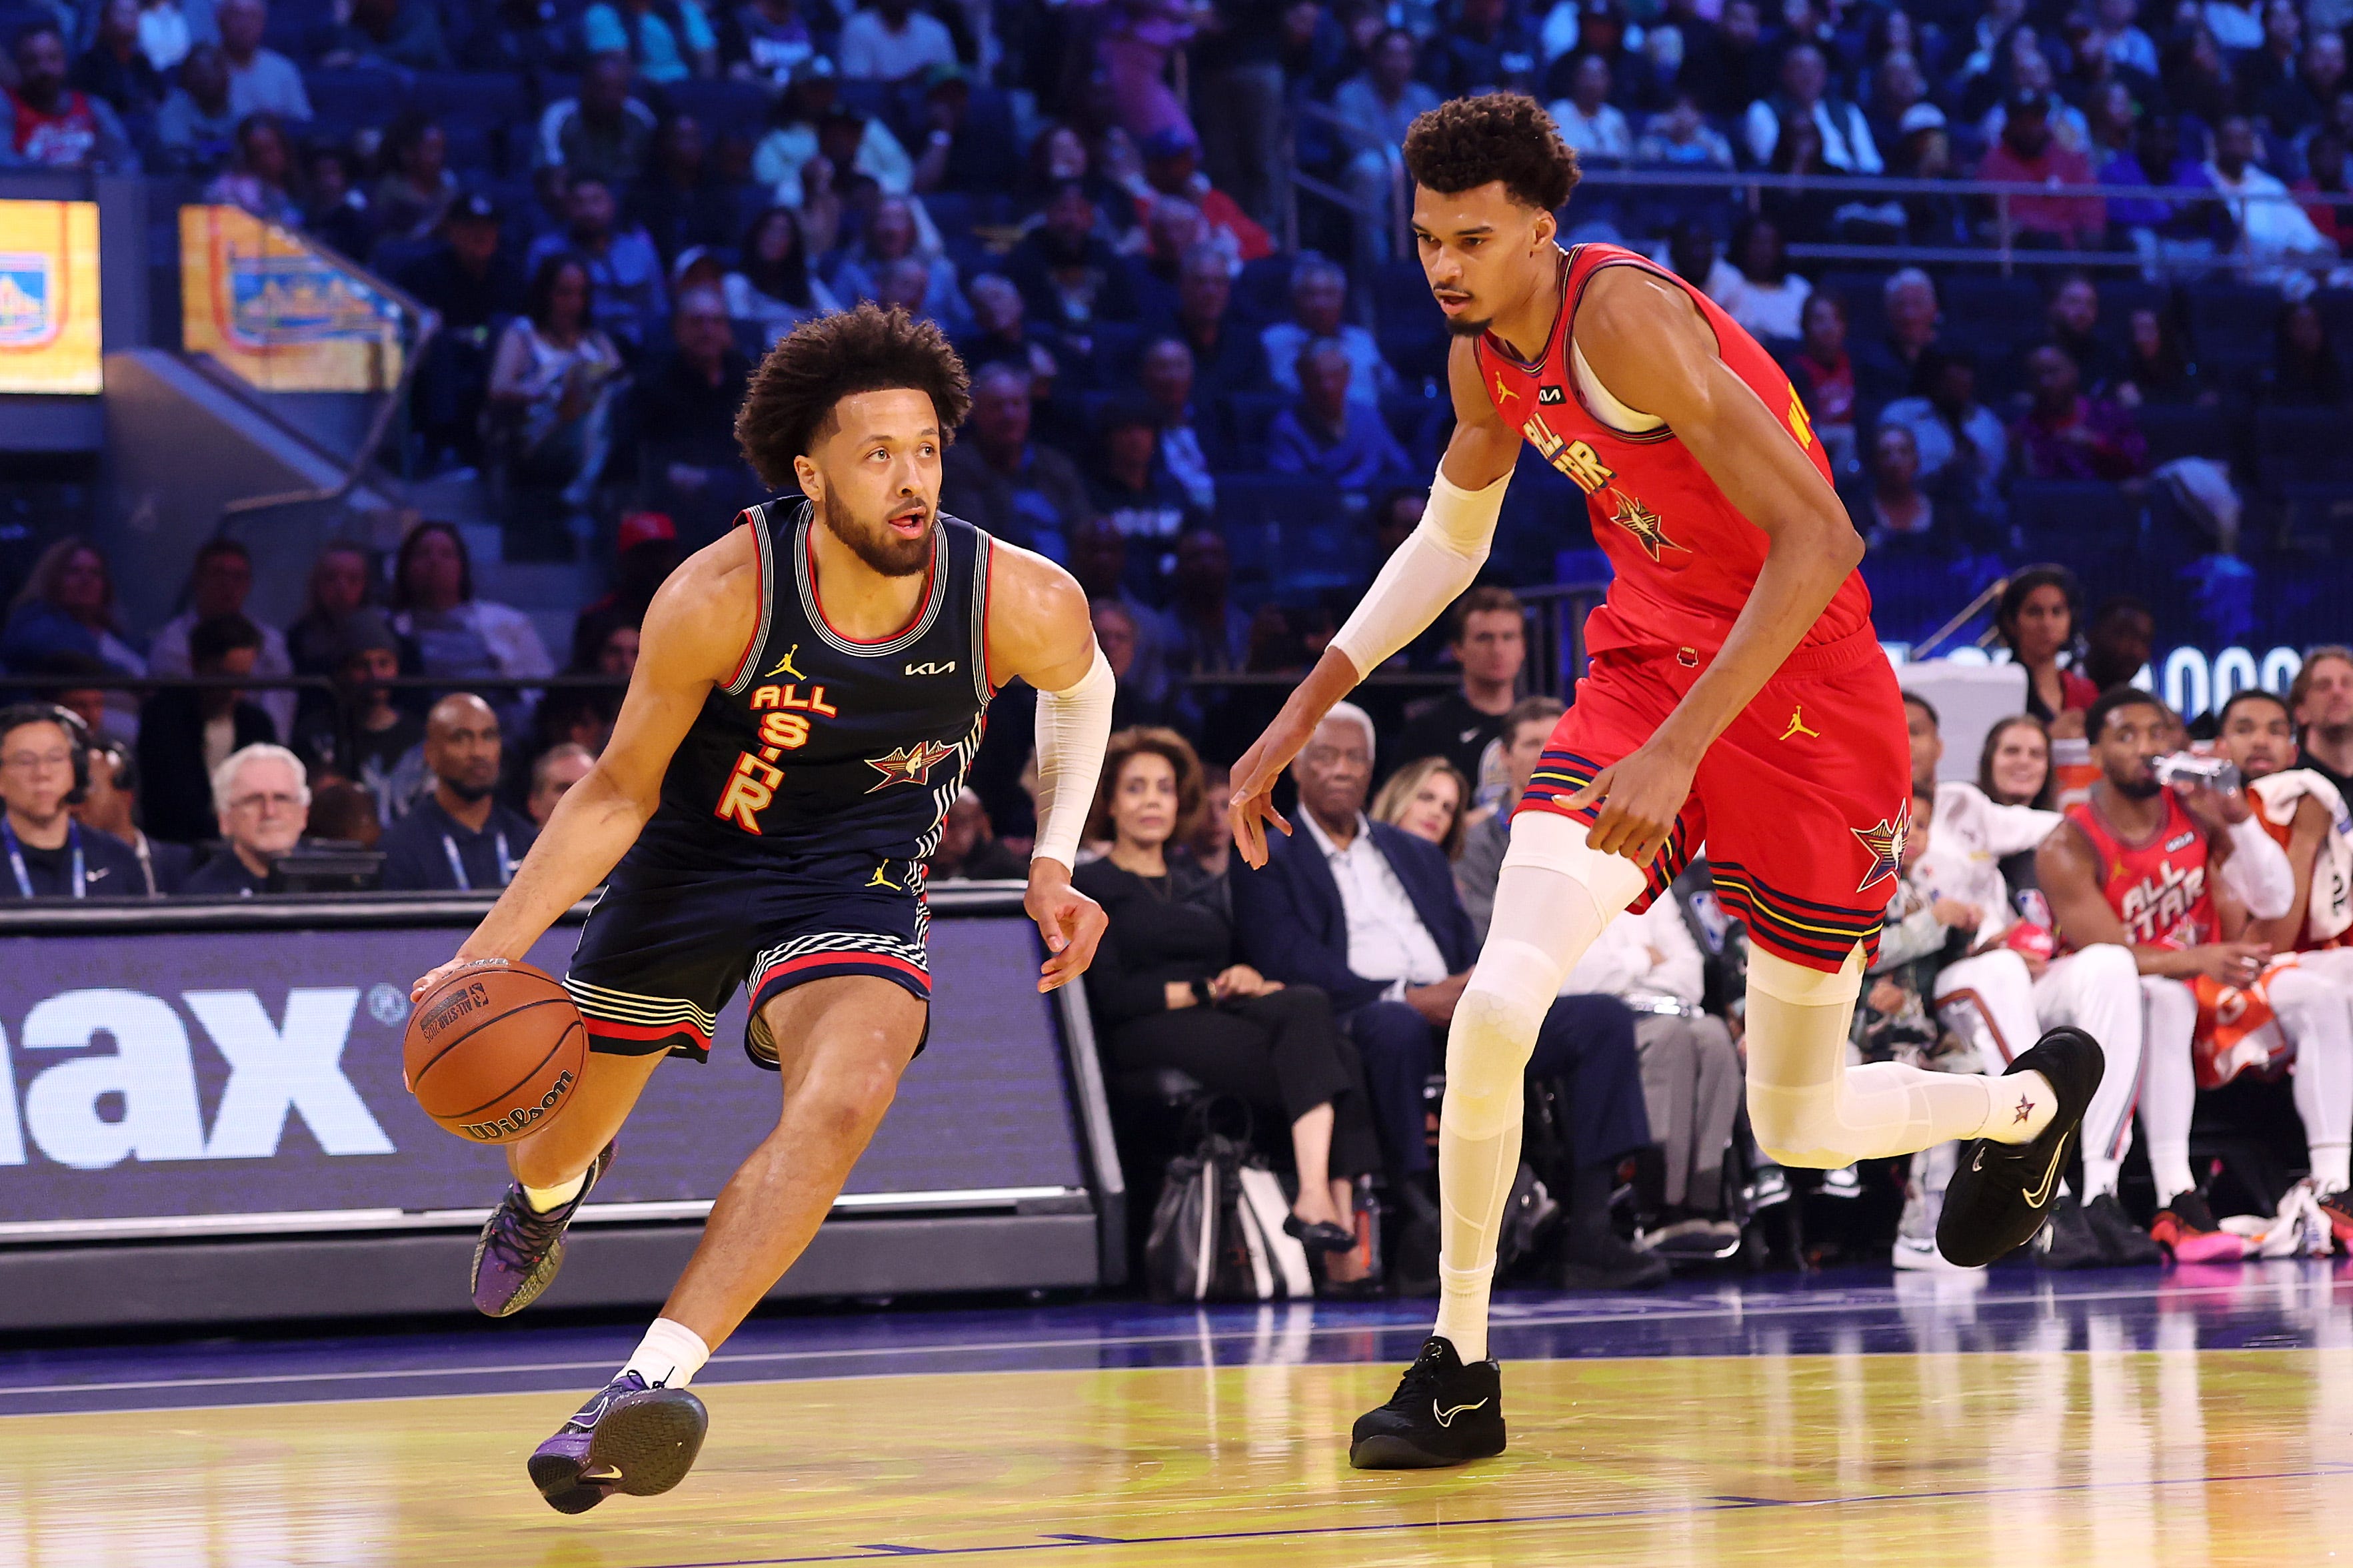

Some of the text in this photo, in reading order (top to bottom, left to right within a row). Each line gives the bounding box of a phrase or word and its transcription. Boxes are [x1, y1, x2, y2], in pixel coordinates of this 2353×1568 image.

[1552, 439, 1618, 498] TAR
[750, 684, 837, 718] ALL
[2122, 859, 2187, 920] ALL
[459, 1069, 575, 1140] Wilson
